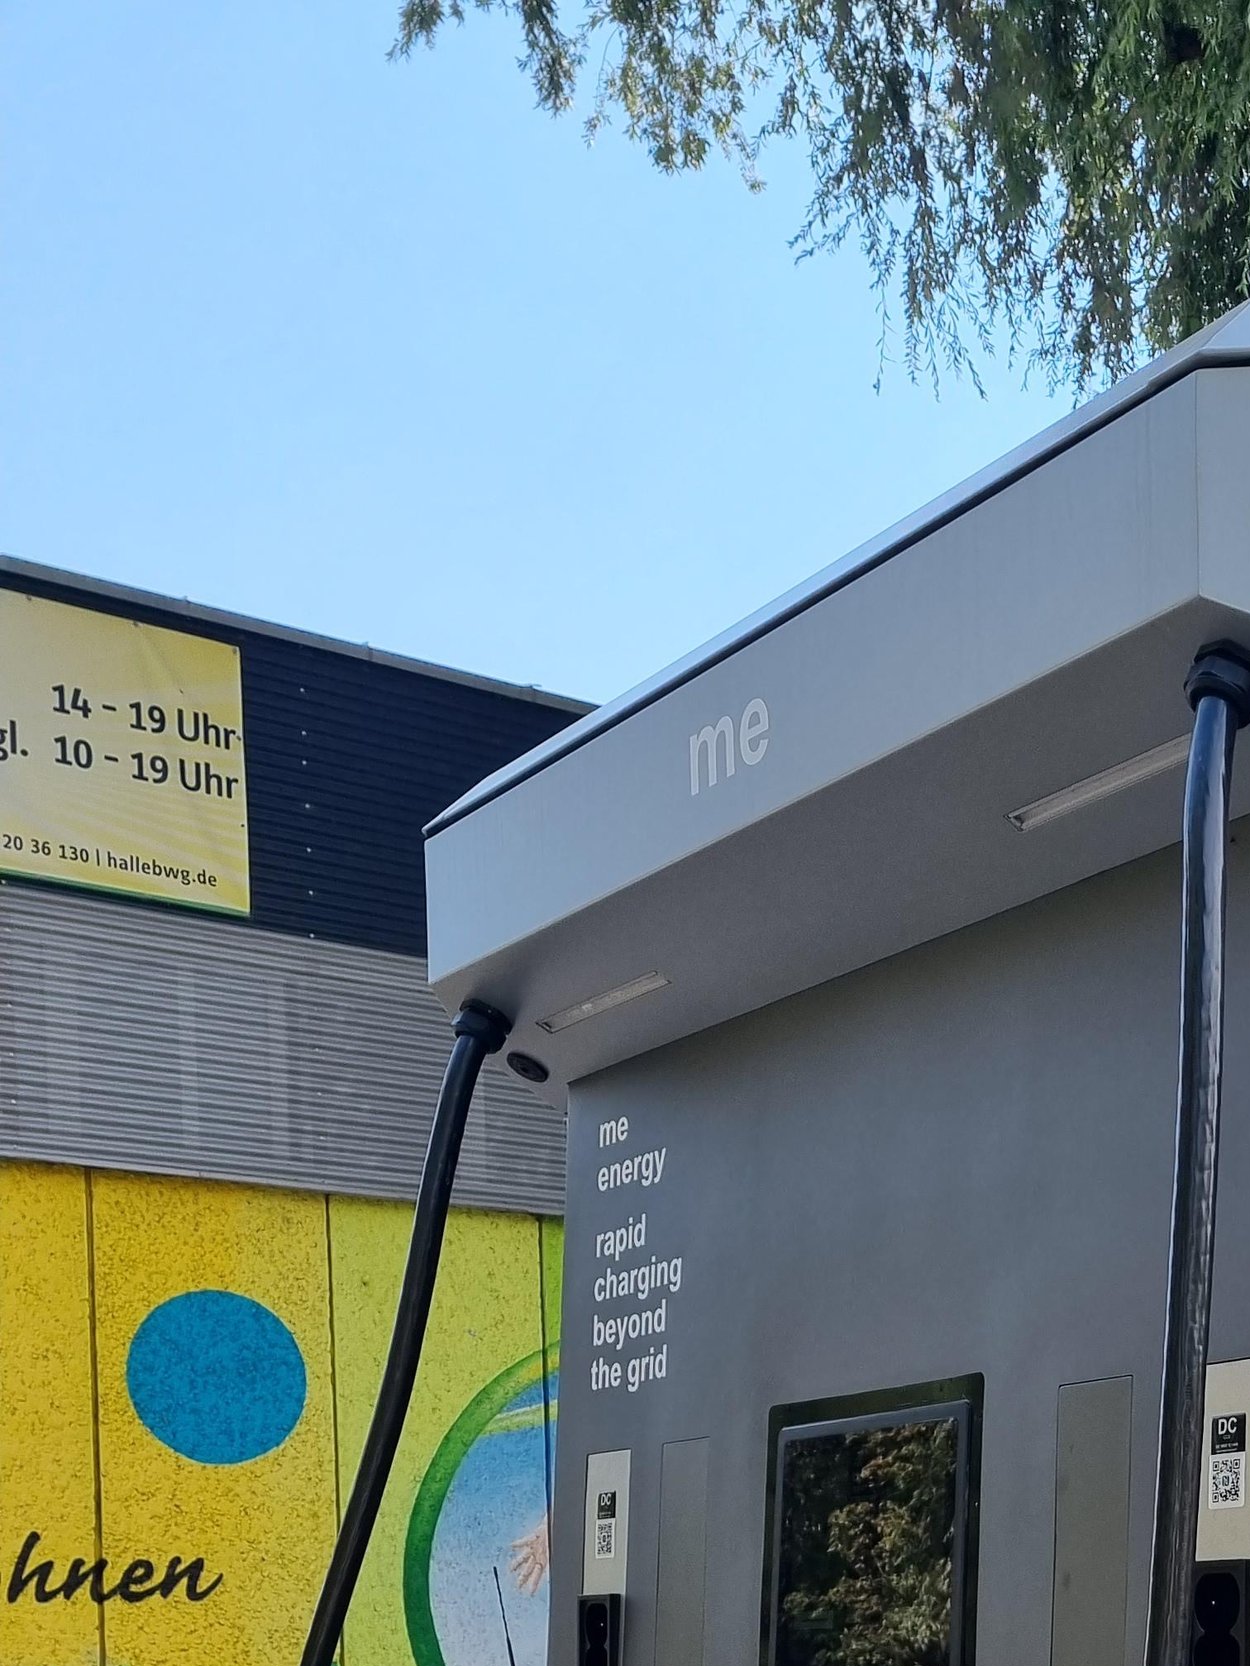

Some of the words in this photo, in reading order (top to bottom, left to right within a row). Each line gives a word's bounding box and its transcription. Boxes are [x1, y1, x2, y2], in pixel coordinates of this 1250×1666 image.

[51, 684, 92, 719] 14
[129, 701, 166, 733] 19
[177, 708, 236, 750] Uhr
[53, 735, 93, 769] 10
[131, 751, 169, 784] 19
[179, 758, 239, 799] Uhr
[690, 698, 769, 796] me
[2, 833, 24, 851] 20
[30, 838, 52, 857] 36
[58, 844, 90, 863] 130
[107, 850, 218, 888] hallebwg.de
[599, 1115, 629, 1148] me
[597, 1147, 667, 1192] energy
[596, 1213, 647, 1262] rapid
[593, 1255, 683, 1302] charging
[593, 1299, 667, 1351] beyond
[590, 1358, 622, 1392] the
[627, 1344, 668, 1393] grid
[1218, 1416, 1238, 1435] DC
[600, 1493, 612, 1506] DC
[0, 1531, 224, 1604] hnen
